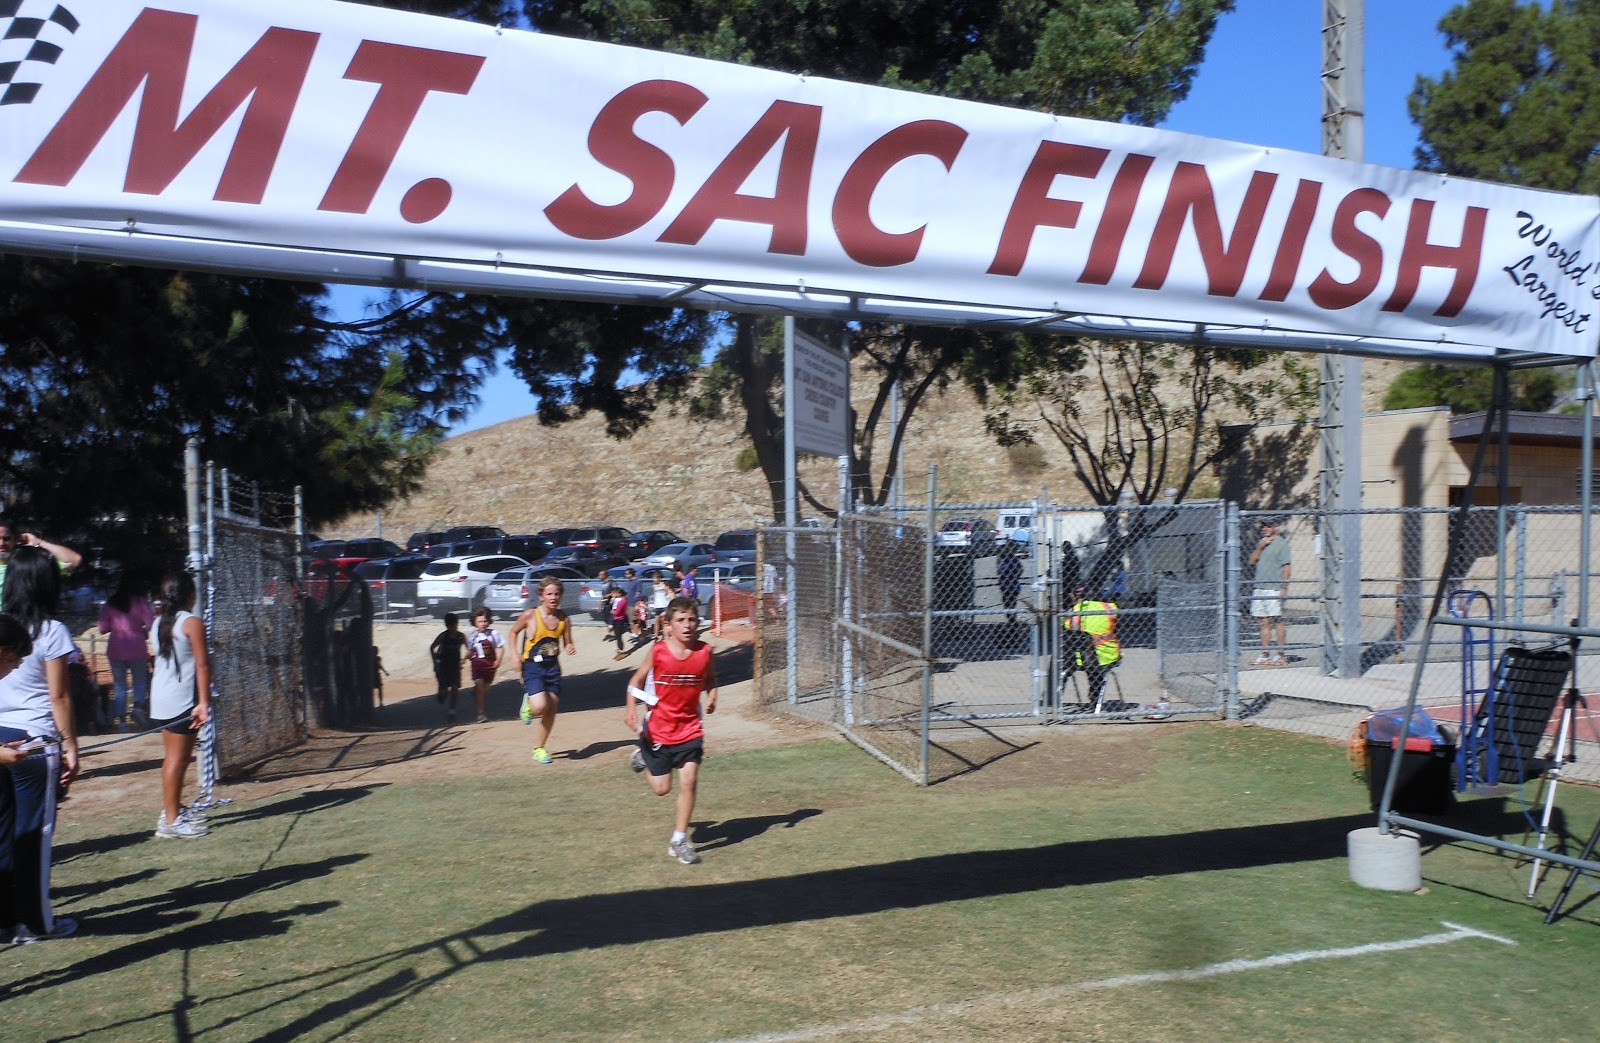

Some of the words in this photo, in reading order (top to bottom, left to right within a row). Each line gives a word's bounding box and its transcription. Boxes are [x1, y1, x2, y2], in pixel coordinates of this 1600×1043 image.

[13, 7, 487, 224] MT.
[542, 79, 970, 268] SAC
[986, 140, 1489, 318] FINISH
[1502, 254, 1591, 334] Largest
